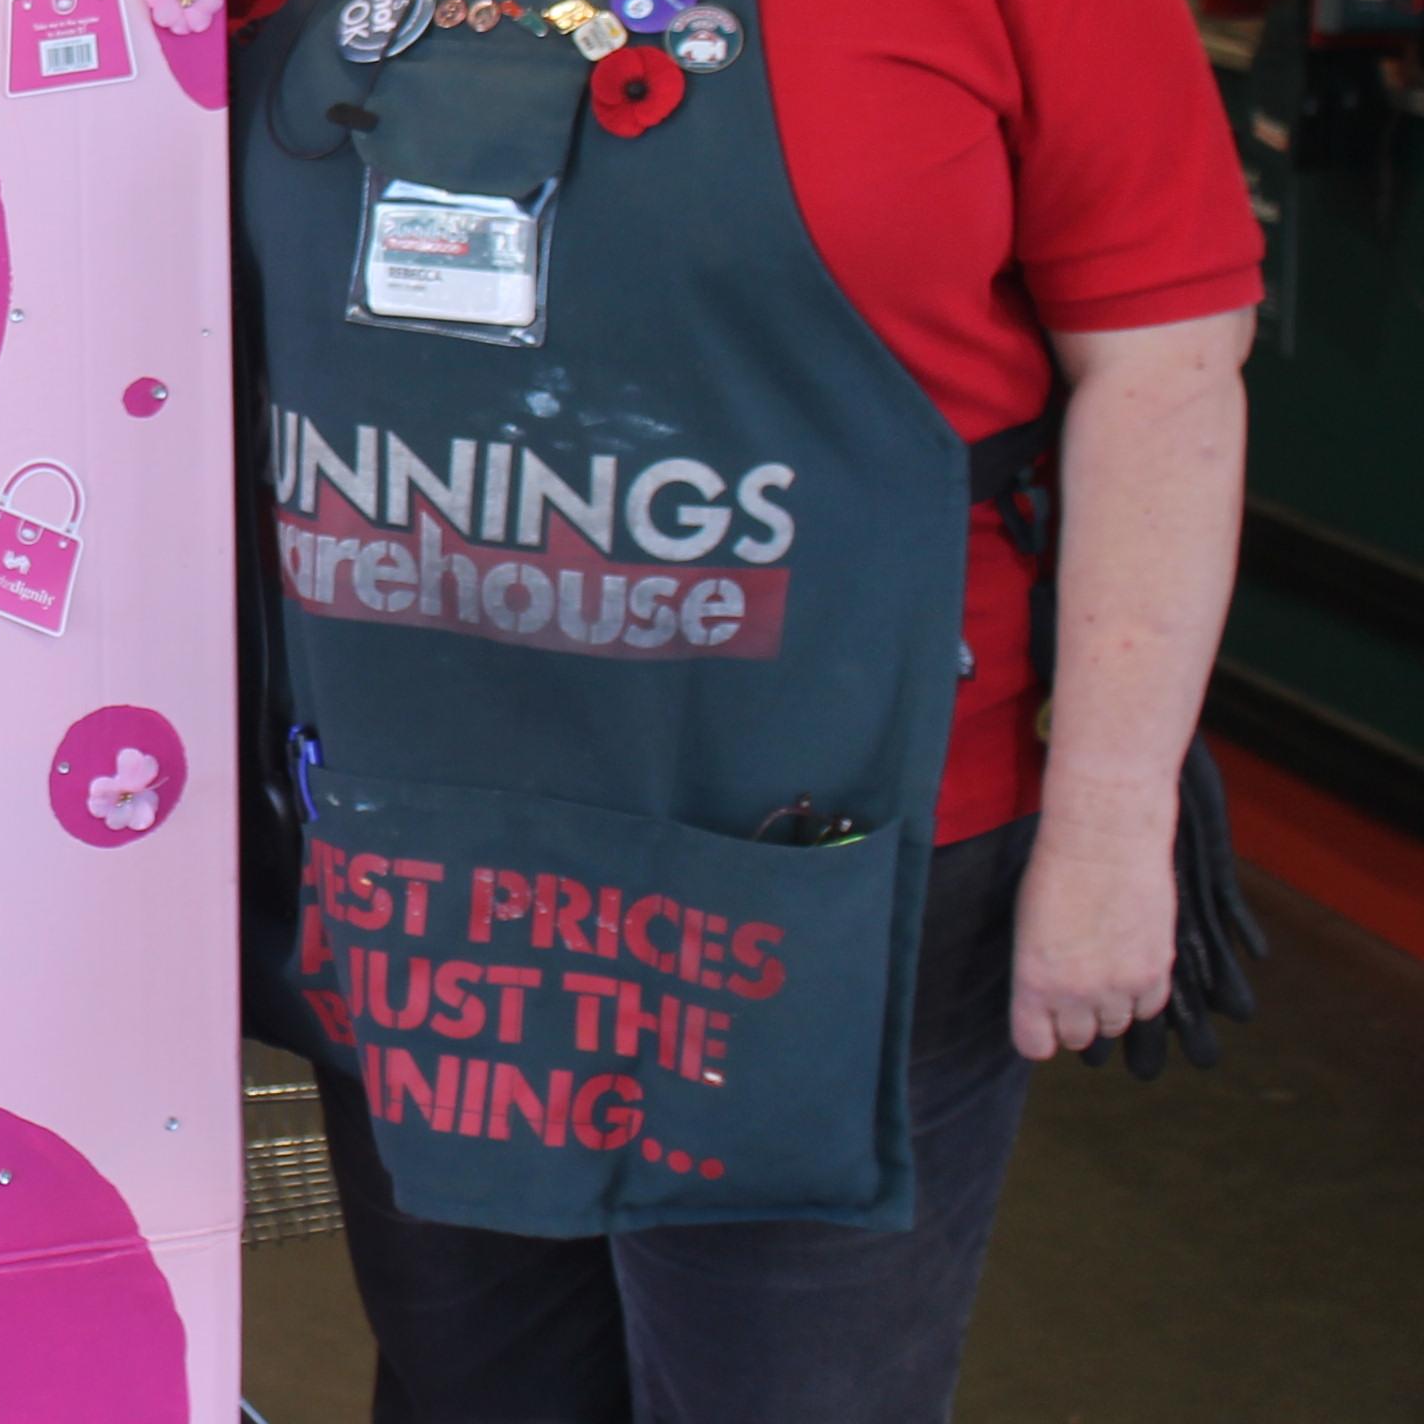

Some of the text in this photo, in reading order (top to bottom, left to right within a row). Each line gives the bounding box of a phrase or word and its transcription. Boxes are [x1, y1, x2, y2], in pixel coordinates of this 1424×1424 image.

[340, 0, 371, 47] OK
[278, 510, 747, 649] arehouse
[467, 866, 787, 1001] PRICES
[563, 972, 733, 1087] THE
